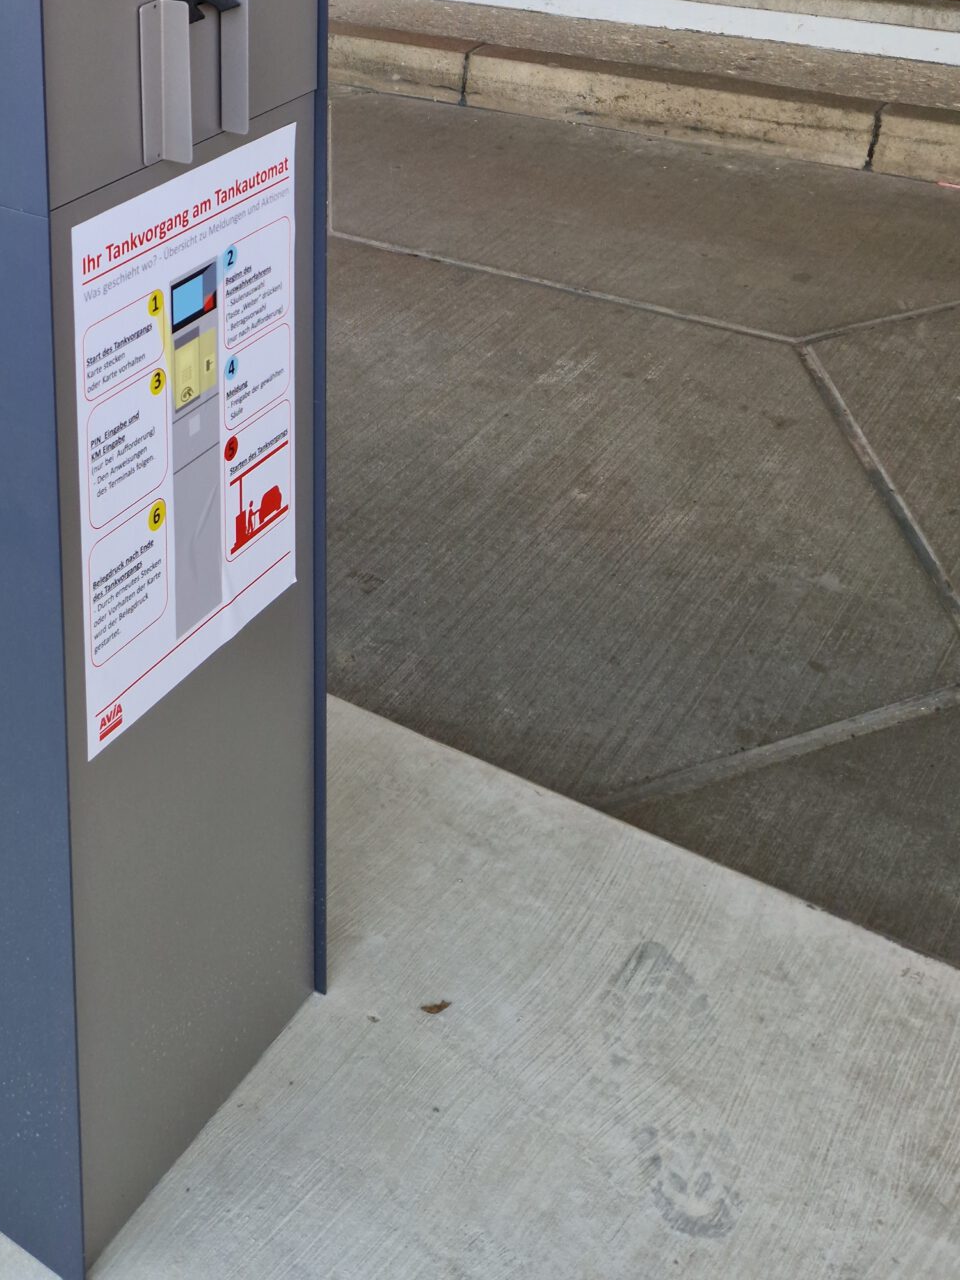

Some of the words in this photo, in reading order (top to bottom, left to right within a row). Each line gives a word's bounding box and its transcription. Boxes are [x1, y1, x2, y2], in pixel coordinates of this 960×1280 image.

[82, 252, 102, 275] Ihr
[106, 208, 189, 262] Tankvorgang
[192, 198, 211, 218] am
[214, 157, 289, 206] Tankautomat
[83, 289, 101, 302] Was
[102, 264, 140, 296] geschieht
[141, 254, 157, 270] wo?
[163, 234, 197, 261] Übersicht
[199, 231, 207, 242] zu
[208, 210, 246, 235] Meldungen
[247, 202, 260, 215] und
[261, 188, 289, 207] Aktionen
[227, 249, 234, 267] 2
[152, 295, 159, 313] 1
[86, 352, 101, 367] Start
[102, 345, 113, 358] des
[113, 323, 153, 352] Tankvorgangs
[87, 365, 102, 379] Karte
[103, 352, 126, 369] stecken
[87, 382, 100, 394] oder
[102, 369, 117, 383] Karte
[118, 352, 146, 374] vorhalten
[228, 359, 235, 375] 4
[154, 372, 162, 390] 3
[128, 410, 140, 426] und
[91, 449, 102, 463] KM
[103, 435, 126, 456] Eingabe
[117, 426, 156, 458] Aufforderung)
[228, 440, 235, 458] 5
[97, 472, 109, 484] Den
[110, 446, 148, 474] Anweisungen
[96, 486, 107, 498] des
[108, 469, 136, 489] Terminals
[153, 507, 161, 524] 6
[93, 561, 125, 590] Belegdruck
[125, 550, 139, 568] nach
[140, 539, 154, 558] Ende
[93, 589, 104, 603] des
[104, 561, 143, 595] Tankvorgangs
[97, 595, 115, 613] Durch
[115, 576, 140, 598] erneutes
[141, 558, 162, 579] Stecken
[93, 613, 107, 628] oder
[108, 592, 136, 616] Vorhalten
[136, 584, 146, 597] der
[146, 571, 162, 588] Karte
[93, 625, 107, 641] wird
[107, 616, 118, 630] der
[118, 592, 149, 621] Belegdruck
[99, 704, 123, 730] AVIA
